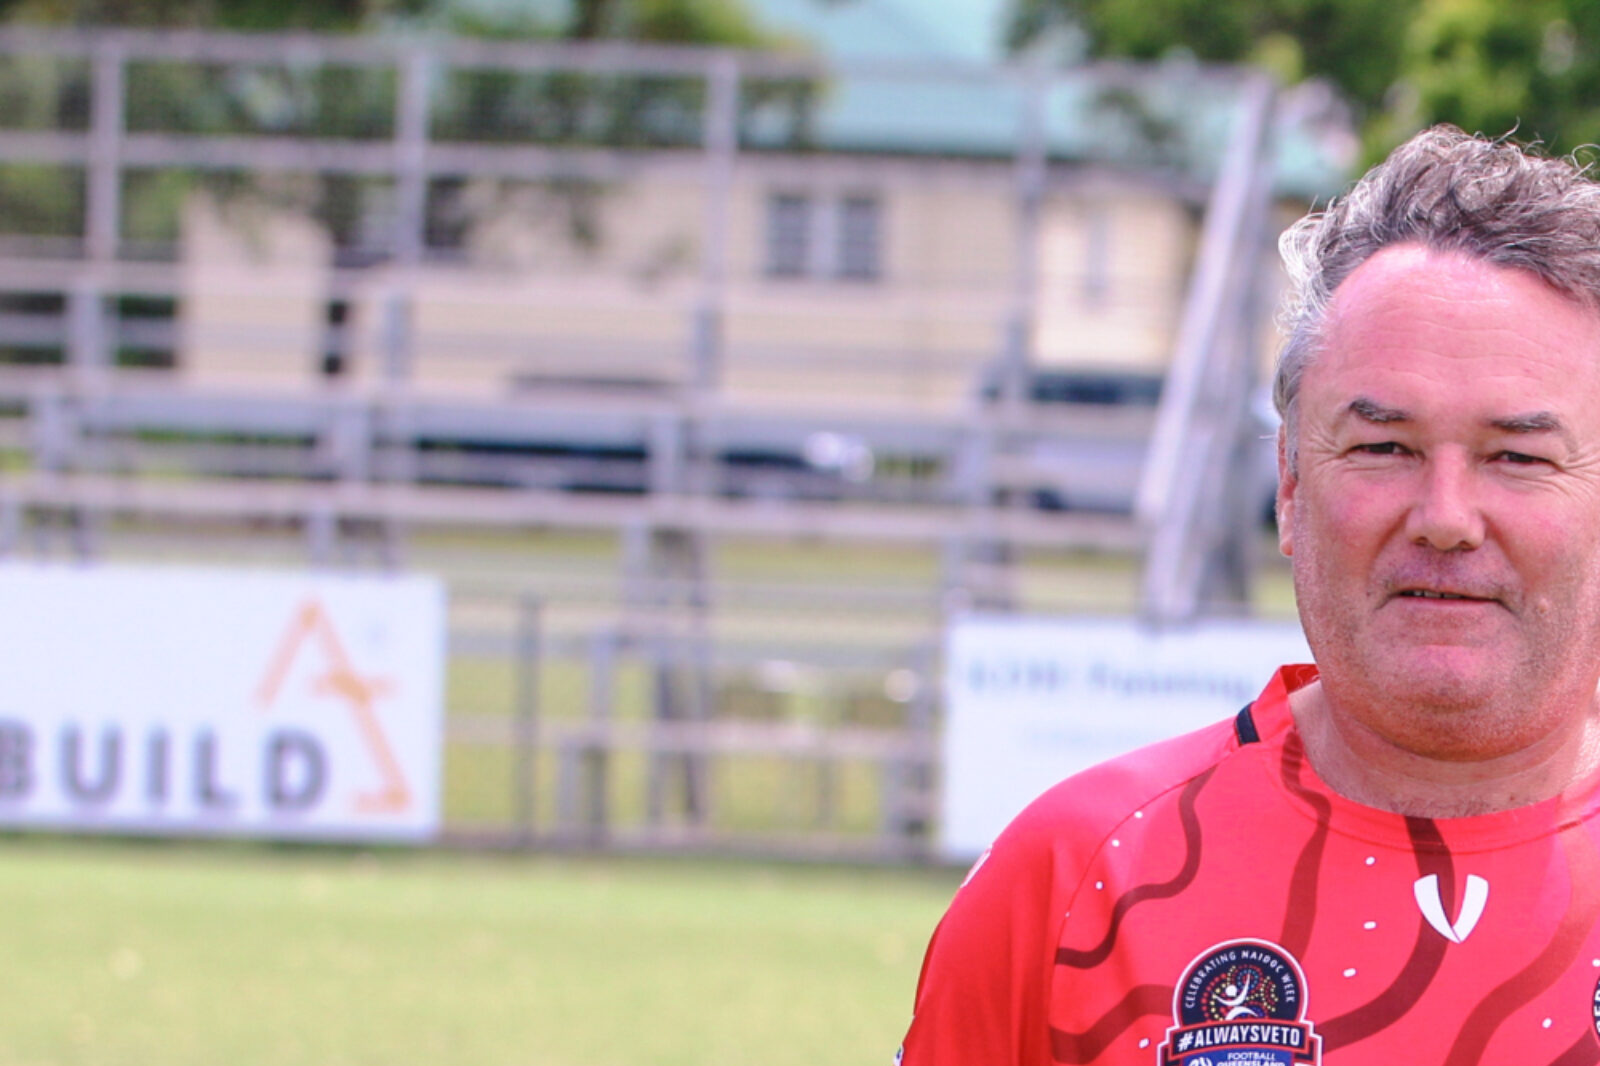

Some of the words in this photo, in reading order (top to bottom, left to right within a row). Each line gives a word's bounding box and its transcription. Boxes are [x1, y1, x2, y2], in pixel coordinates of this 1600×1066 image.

[1185, 951, 1236, 1009] CELEBRATING
[1241, 950, 1284, 973] NAIDOC
[1281, 973, 1296, 1003] WEEK
[1178, 1024, 1300, 1052] #ALWAYSVETO
[1227, 1052, 1275, 1060] FOOTBALL
